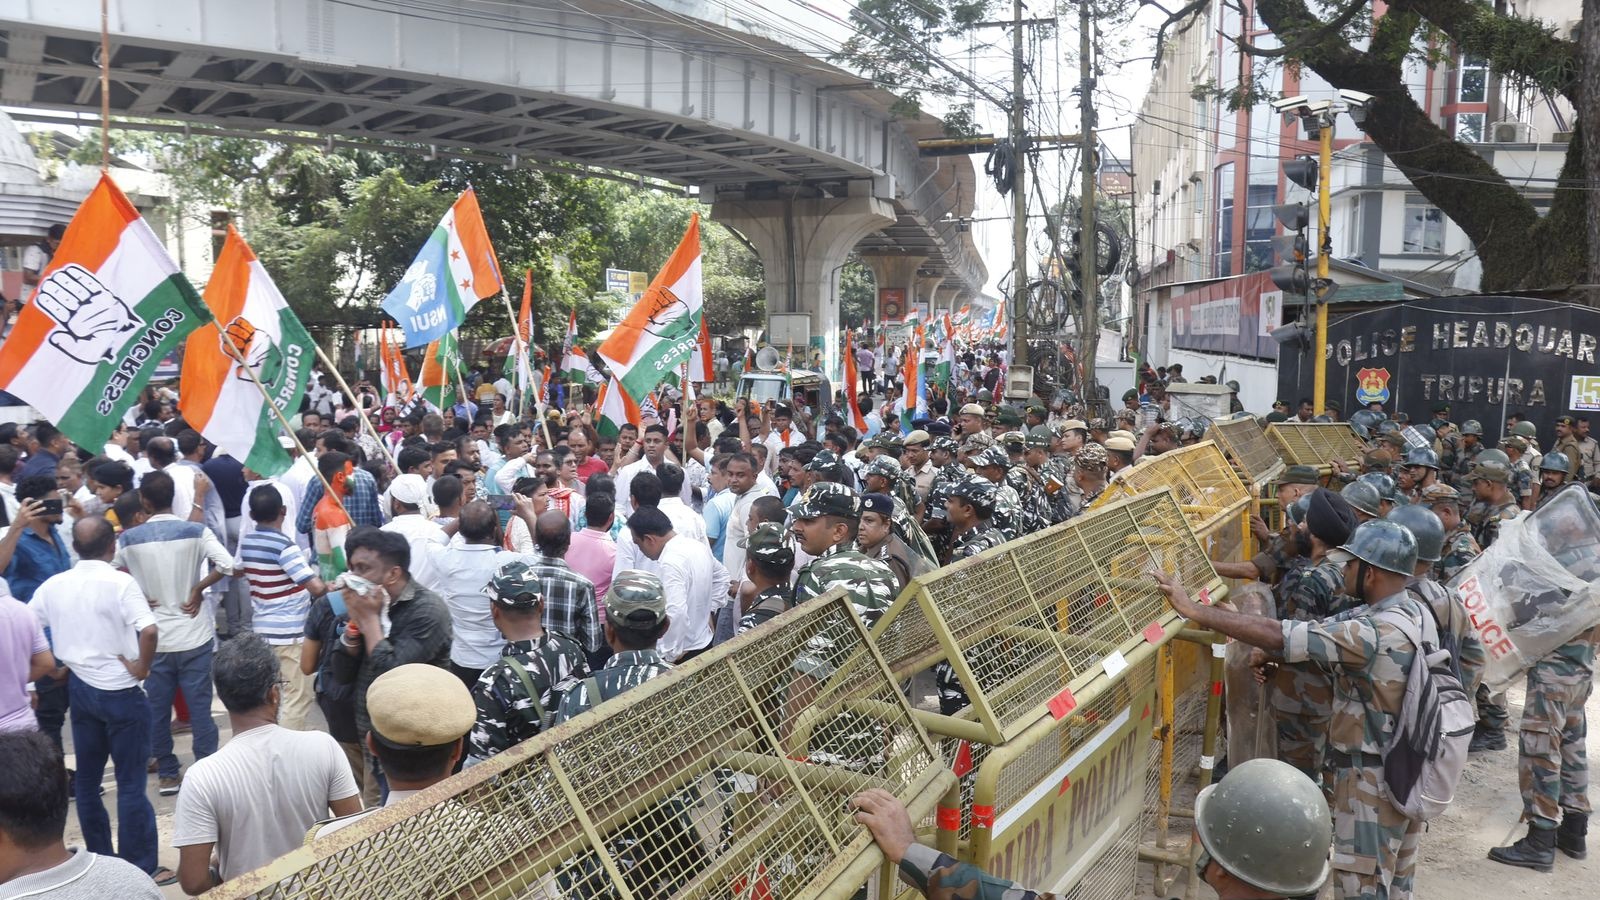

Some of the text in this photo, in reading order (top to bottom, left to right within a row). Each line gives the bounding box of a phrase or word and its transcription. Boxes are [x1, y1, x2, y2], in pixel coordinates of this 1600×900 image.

[1420, 374, 1547, 407] TRIPURA
[1459, 576, 1513, 660] POLICE
[1065, 726, 1138, 856] POLICE
